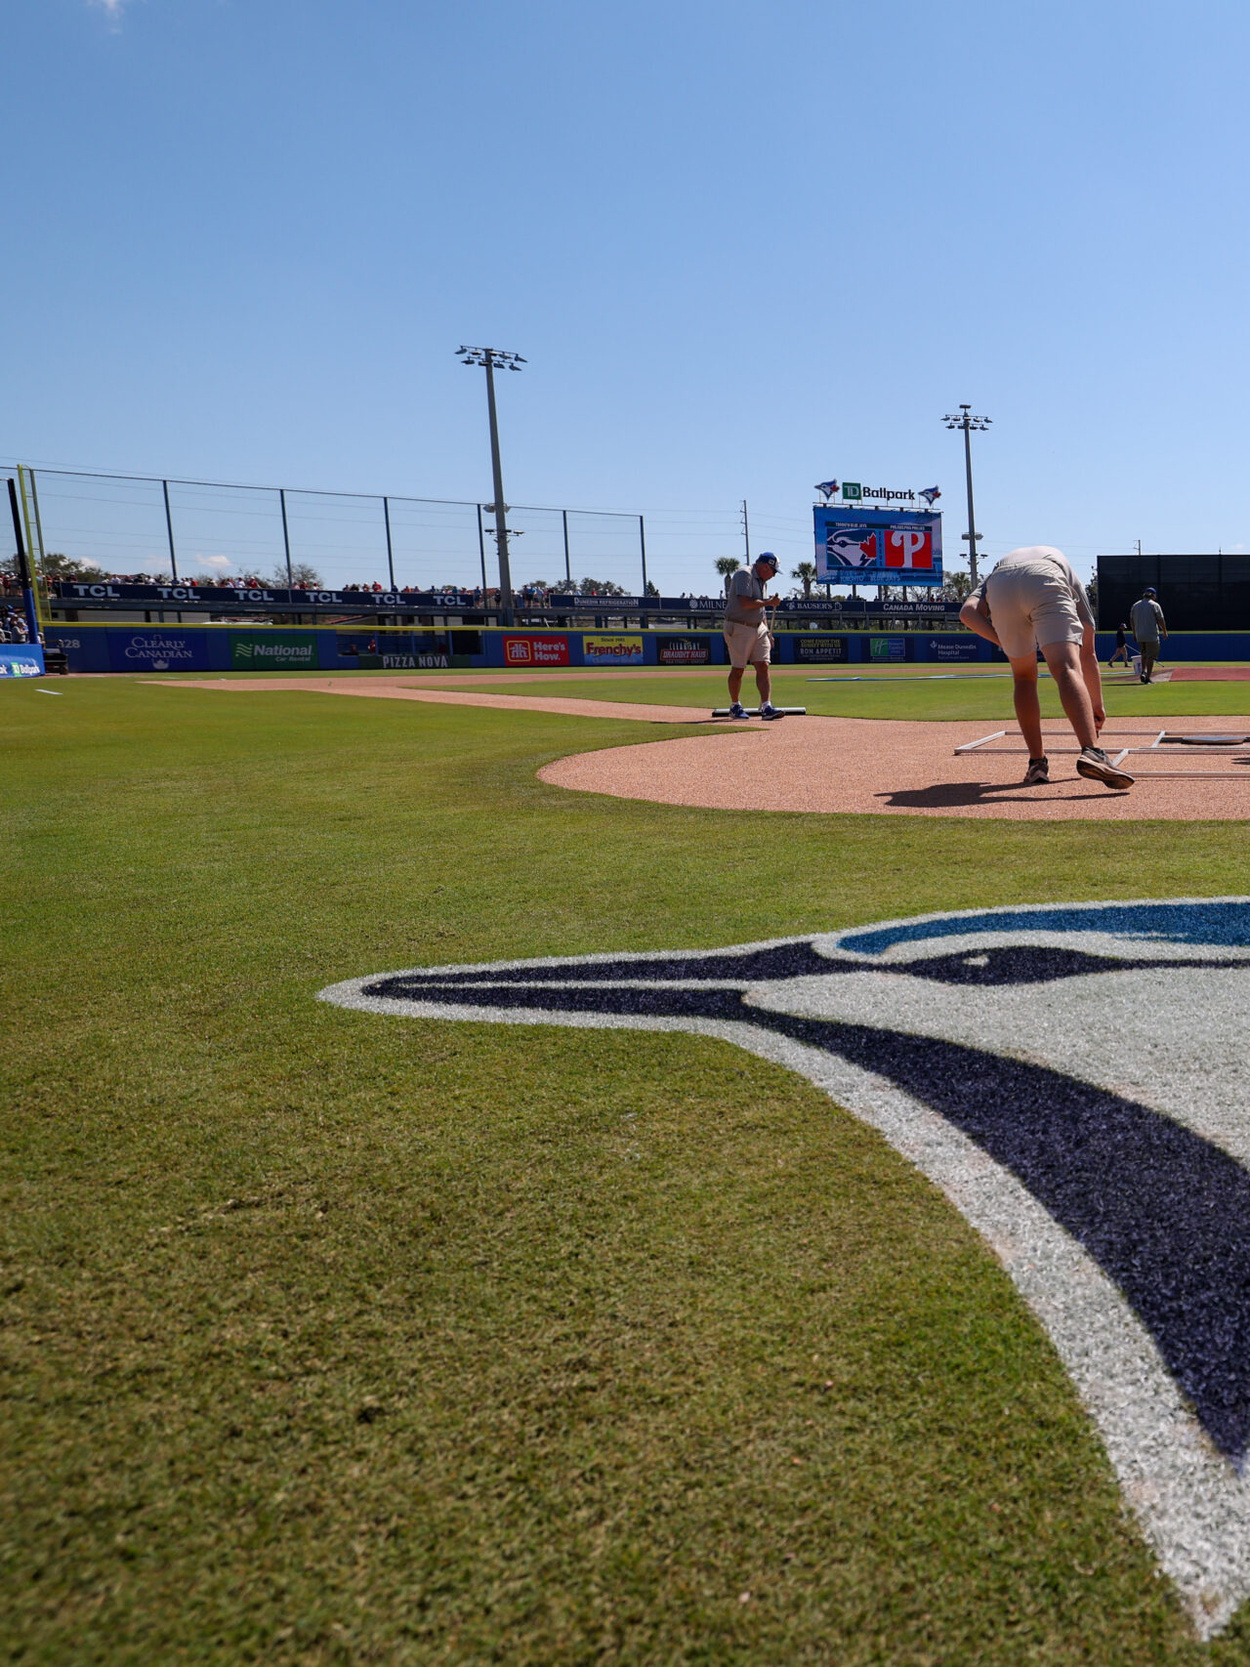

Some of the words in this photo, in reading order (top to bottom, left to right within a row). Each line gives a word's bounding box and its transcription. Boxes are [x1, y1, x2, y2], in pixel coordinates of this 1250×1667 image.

[844, 485, 860, 496] TD
[862, 487, 916, 501] Ballpark
[73, 585, 120, 597] TCL
[157, 587, 200, 599] TCL
[235, 590, 274, 601] TCL
[305, 591, 343, 603] TCL
[371, 594, 406, 604] TCL
[433, 595, 466, 606] TCL
[883, 603, 914, 611] CANADA
[131, 637, 187, 650] CLEARLY
[533, 641, 566, 651] Here's
[586, 642, 641, 656] Frenchy's
[125, 648, 192, 659] CANADIAN
[253, 644, 312, 656] National
[534, 651, 561, 661] How.
[383, 655, 415, 668] PIZZA
[418, 655, 449, 668] NOVA
